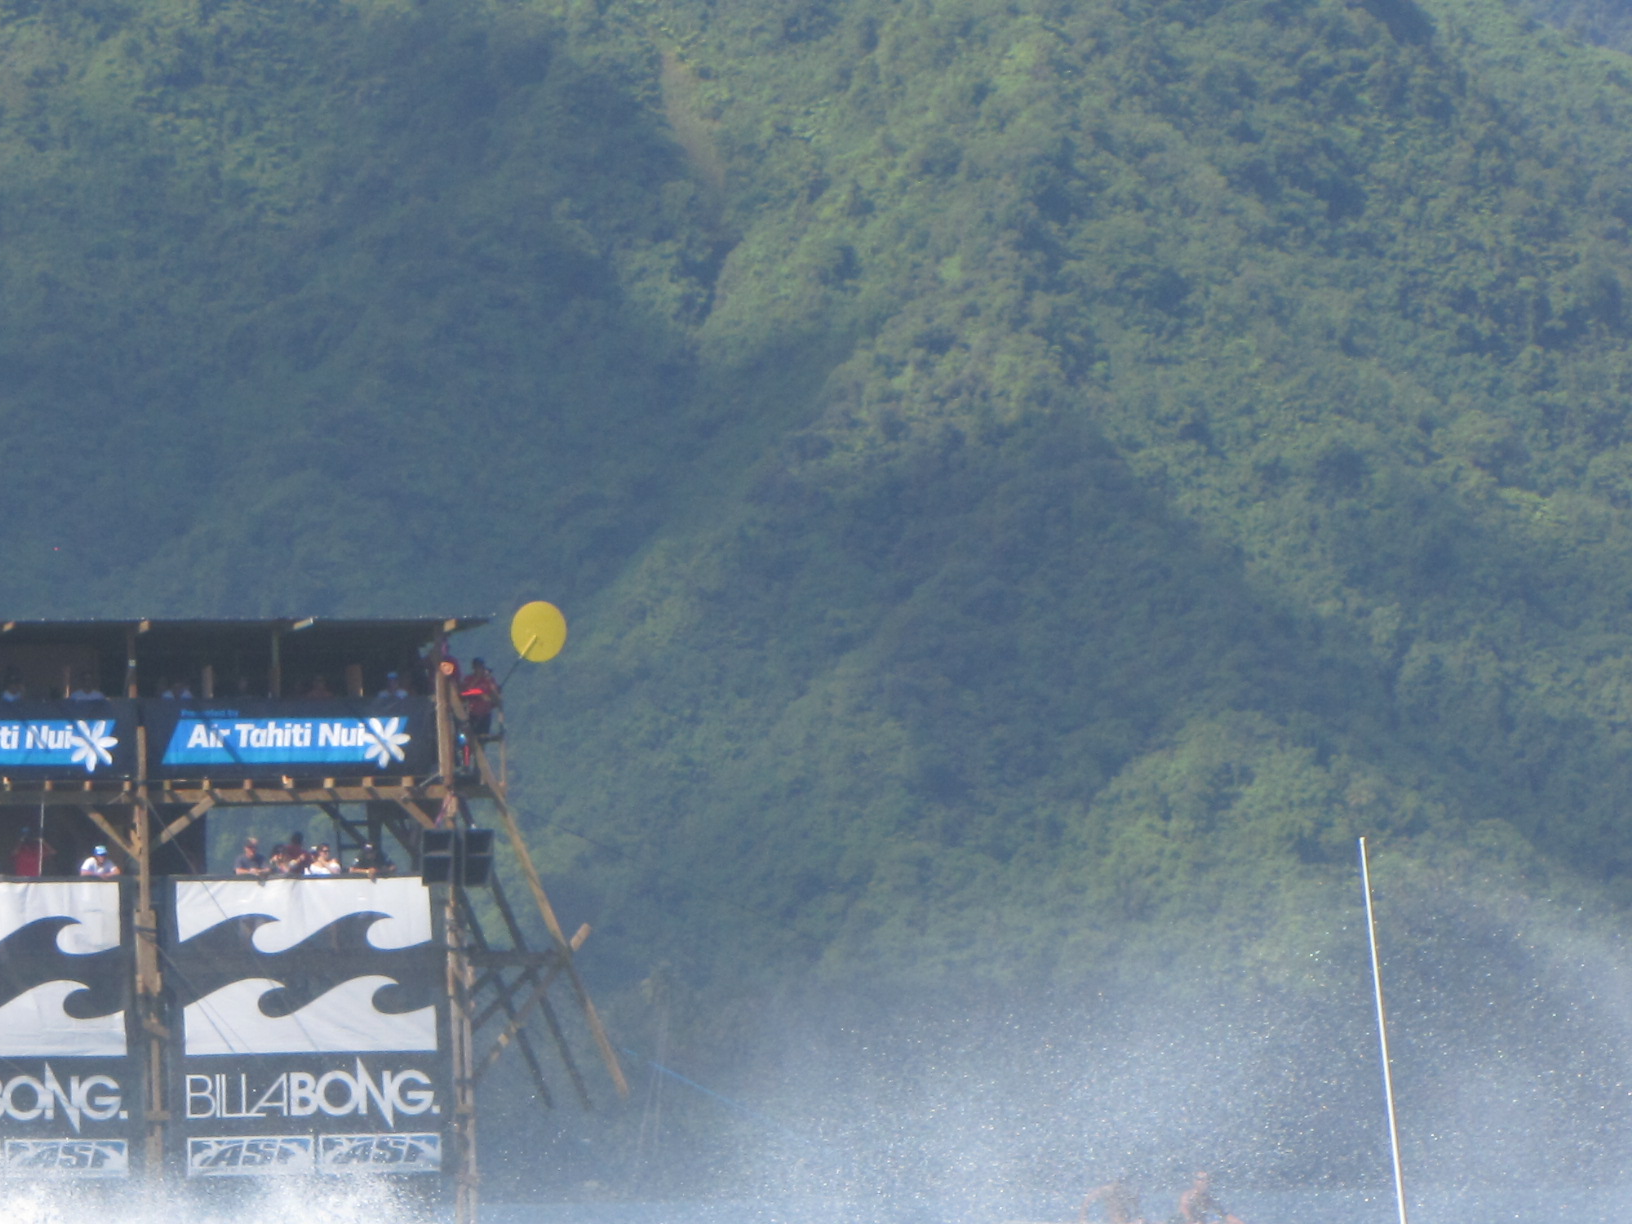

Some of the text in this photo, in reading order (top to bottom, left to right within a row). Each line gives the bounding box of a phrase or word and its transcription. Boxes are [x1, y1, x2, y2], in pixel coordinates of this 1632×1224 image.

[25, 725, 73, 750] Nui
[187, 721, 366, 748] Air Tahiti Nui
